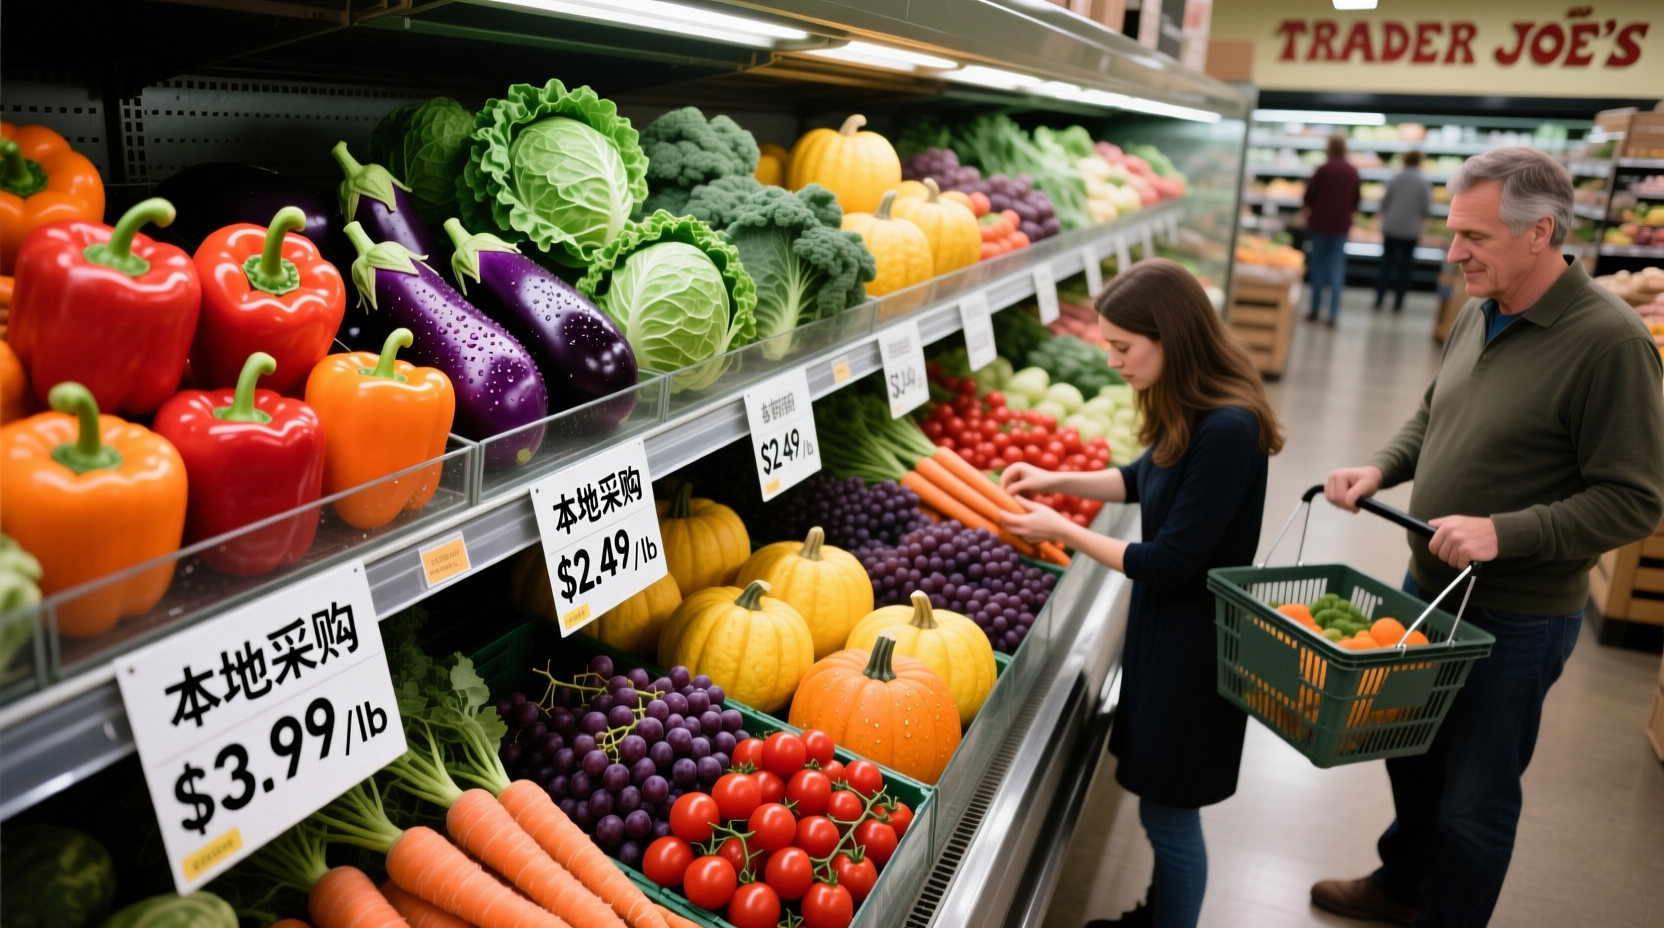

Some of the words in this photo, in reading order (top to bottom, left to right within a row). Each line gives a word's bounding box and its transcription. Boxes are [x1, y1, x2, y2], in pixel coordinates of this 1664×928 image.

[1275, 19, 1478, 64] TRADER
[552, 466, 643, 535] 本地采购
[164, 602, 359, 728] 本地采购
